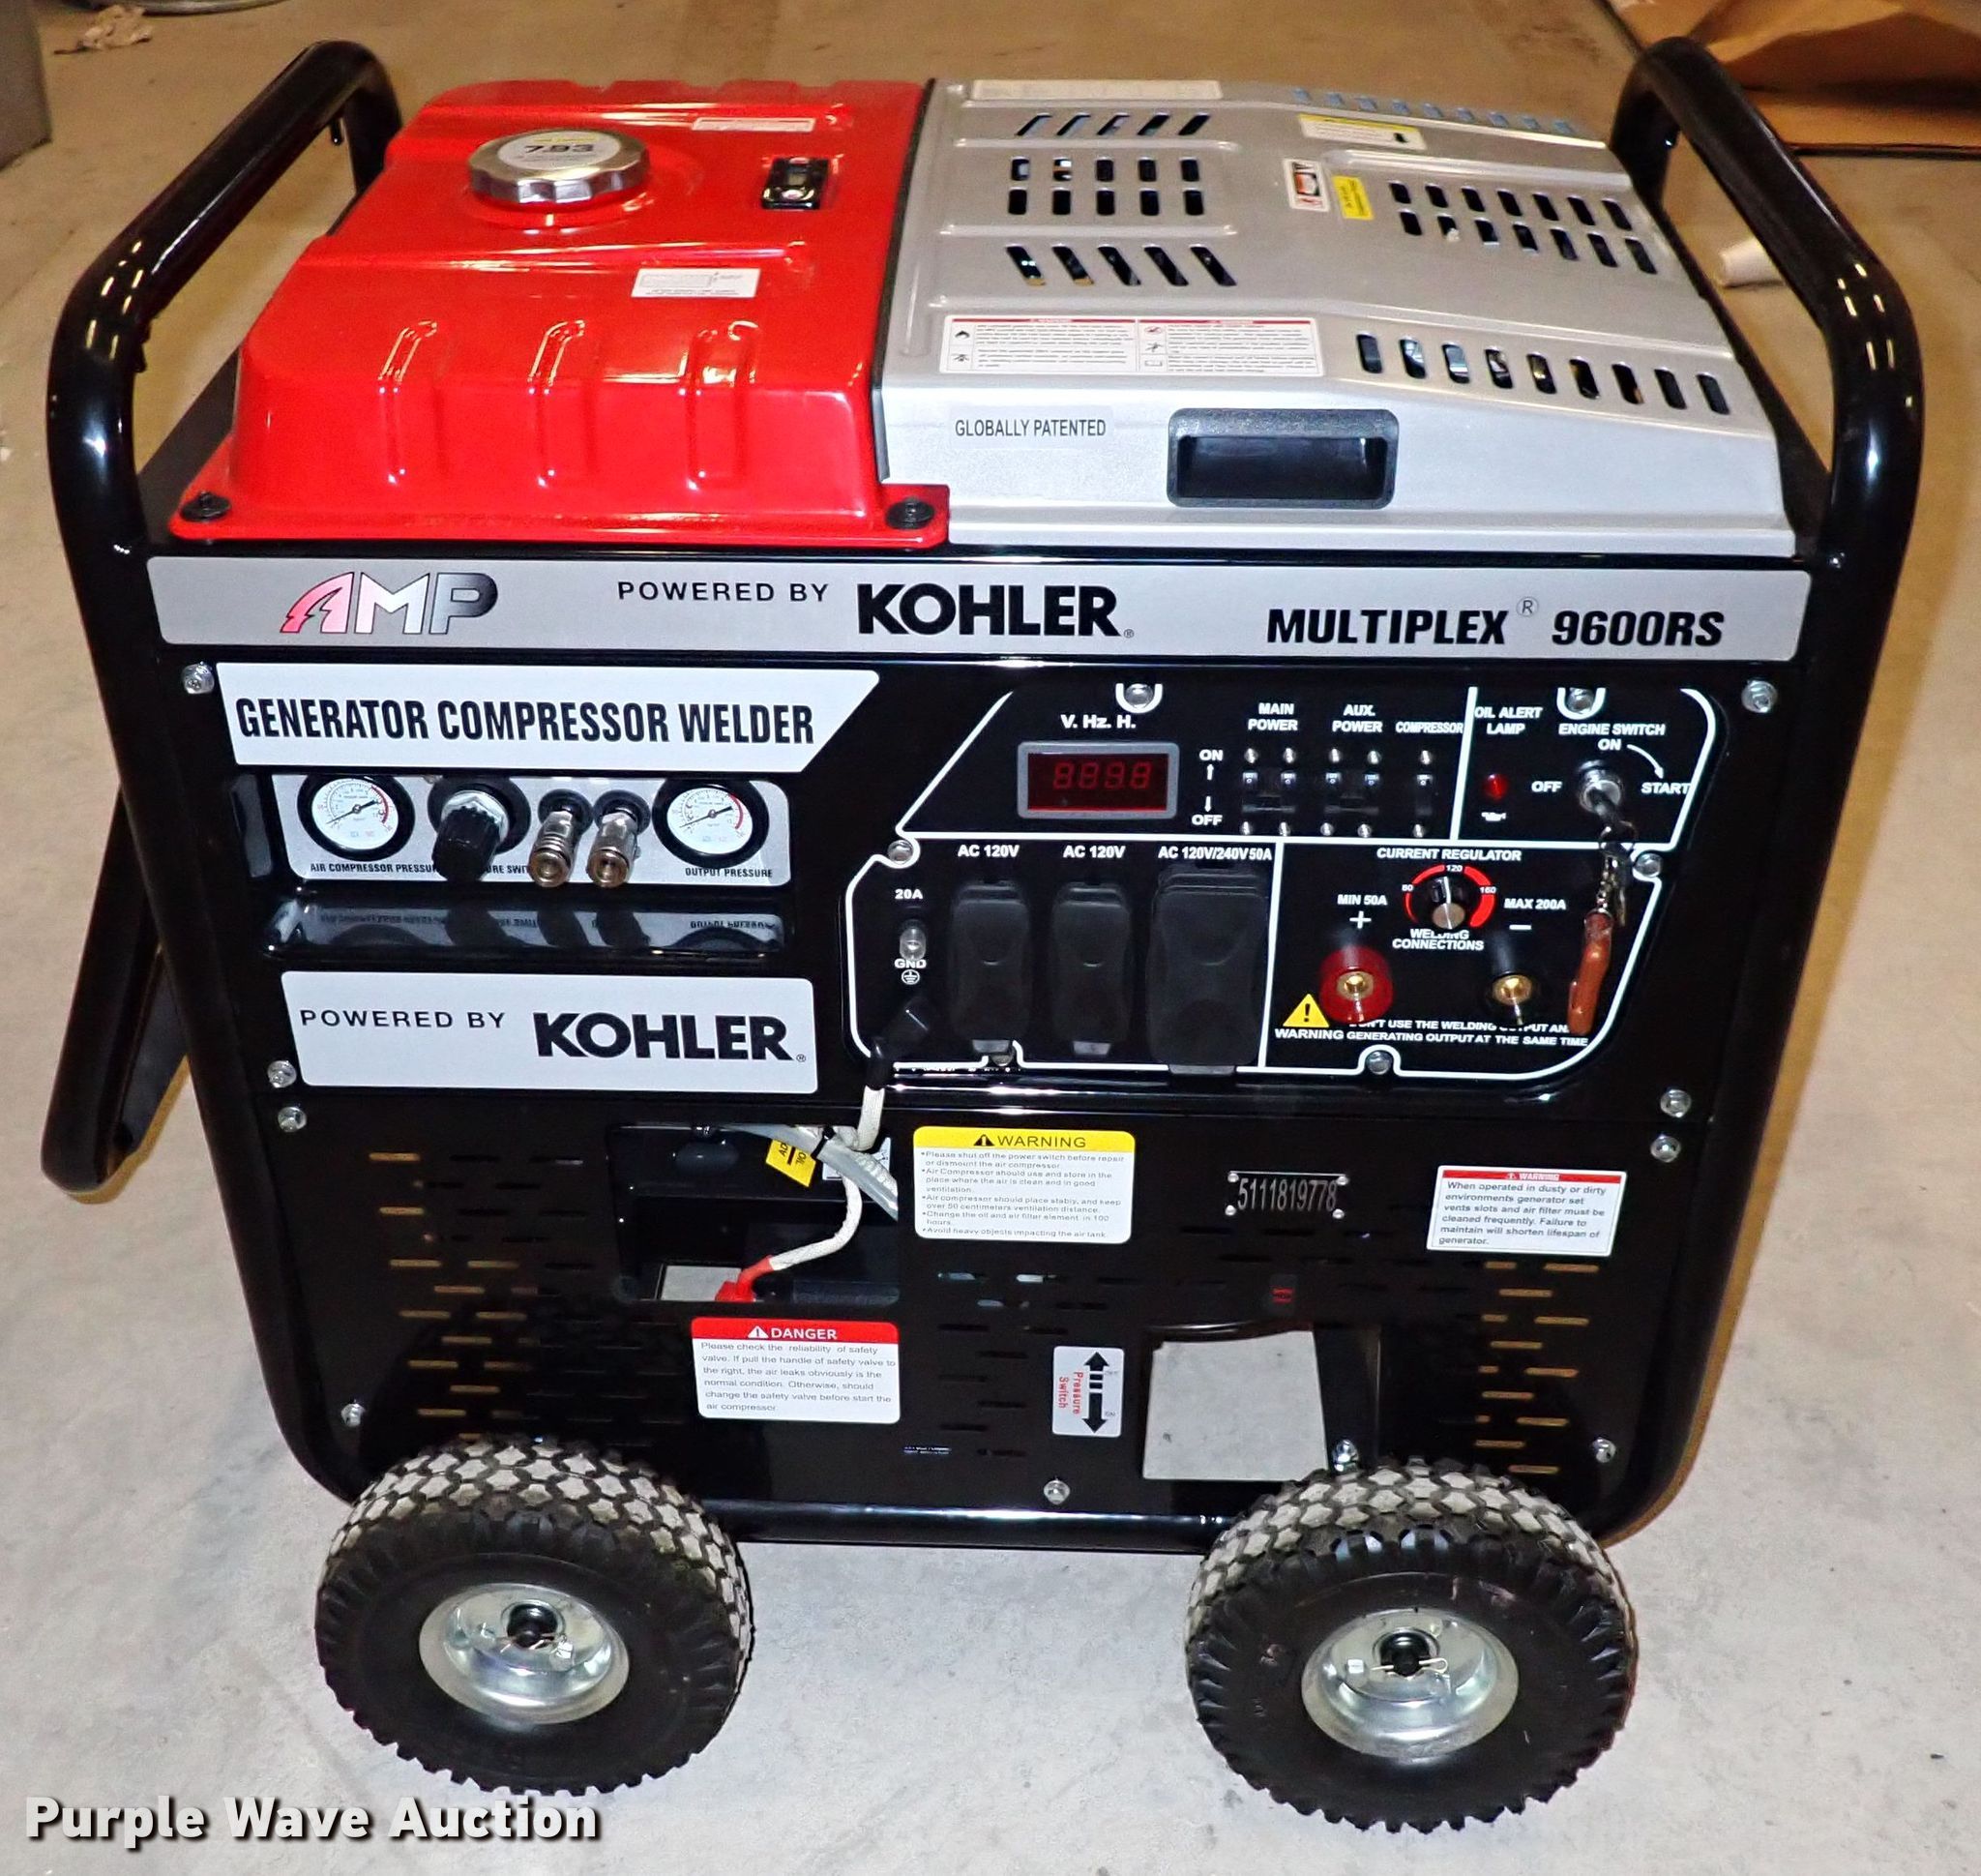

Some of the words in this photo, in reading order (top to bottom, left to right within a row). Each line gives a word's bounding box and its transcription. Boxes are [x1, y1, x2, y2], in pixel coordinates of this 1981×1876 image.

[955, 419, 1030, 436] GLOBALLY
[1033, 419, 1107, 436] PATENTED
[618, 581, 775, 602] POWERED
[790, 582, 829, 603] BY
[280, 571, 498, 636] AMP
[1267, 609, 1509, 644] MULTIPLEX
[1552, 610, 1725, 646] 9600RS
[1257, 702, 1294, 715] MAIN
[1343, 704, 1375, 716] AUX.
[1474, 706, 1496, 718] OIL
[1498, 706, 1543, 719] ALERT
[236, 697, 429, 740] GENERATOR
[438, 700, 670, 742] COMPRESSOR
[677, 703, 814, 744] WELDER
[1060, 714, 1078, 729] V.
[1082, 714, 1111, 729] Hz.
[1116, 714, 1136, 729] H.
[1248, 719, 1298, 731] POWER
[1332, 720, 1383, 732] POWER
[1395, 721, 1464, 733] COMPRESSOR
[1486, 723, 1525, 734] LAMP
[1558, 724, 1611, 735] ENGINE
[1611, 724, 1666, 736] SWITCH
[1598, 738, 1621, 751] ON
[1199, 749, 1224, 761] ON
[1531, 781, 1562, 792] OFF
[1641, 782, 1692, 794] START
[1192, 815, 1223, 826] OFF
[958, 845, 980, 857] AC
[984, 845, 1020, 857] 120V
[1063, 846, 1086, 858] AC
[1089, 846, 1126, 859] 120V
[1158, 847, 1179, 859] AC
[1376, 848, 1438, 860] CURRENT
[1441, 849, 1522, 861] REGULATOR
[310, 863, 326, 872] AIR
[329, 863, 394, 873] COMPRESSOR
[685, 867, 721, 877] OUTPUT
[724, 869, 773, 878] PRESSURE
[895, 889, 924, 900] 20A
[1337, 894, 1362, 906] MIN
[1364, 895, 1388, 906] 50A
[1504, 898, 1533, 909] MAX
[1535, 899, 1566, 910] 200A
[1392, 938, 1485, 950] CONNECTIONS
[894, 958, 927, 968] GND
[300, 1009, 454, 1027] POWERED
[468, 1011, 506, 1028] BY
[1388, 1020, 1412, 1028] USE
[1414, 1021, 1438, 1029] THE
[1441, 1021, 1496, 1030] WELDING
[1274, 1028, 1345, 1040] WARNING
[1346, 1030, 1424, 1041] GENERATING
[1426, 1033, 1475, 1043] OUTPUT
[1495, 1035, 1519, 1045] THE
[1523, 1036, 1556, 1046] SAME
[1559, 1037, 1588, 1047] TIME
[997, 1135, 1086, 1147] WARNING
[1237, 1177, 1337, 1211] 5111819778
[1447, 1181, 1476, 1190] When
[1538, 1185, 1567, 1194] dusty
[1582, 1186, 1606, 1196] dirty
[1540, 1217, 1574, 1226] Failure
[1505, 1227, 1544, 1236] shorten
[1547, 1229, 1586, 1238] lifespan
[770, 1327, 838, 1340] DANGER
[1058, 1376, 1070, 1409] Switch
[1072, 1371, 1083, 1414] Pressure
